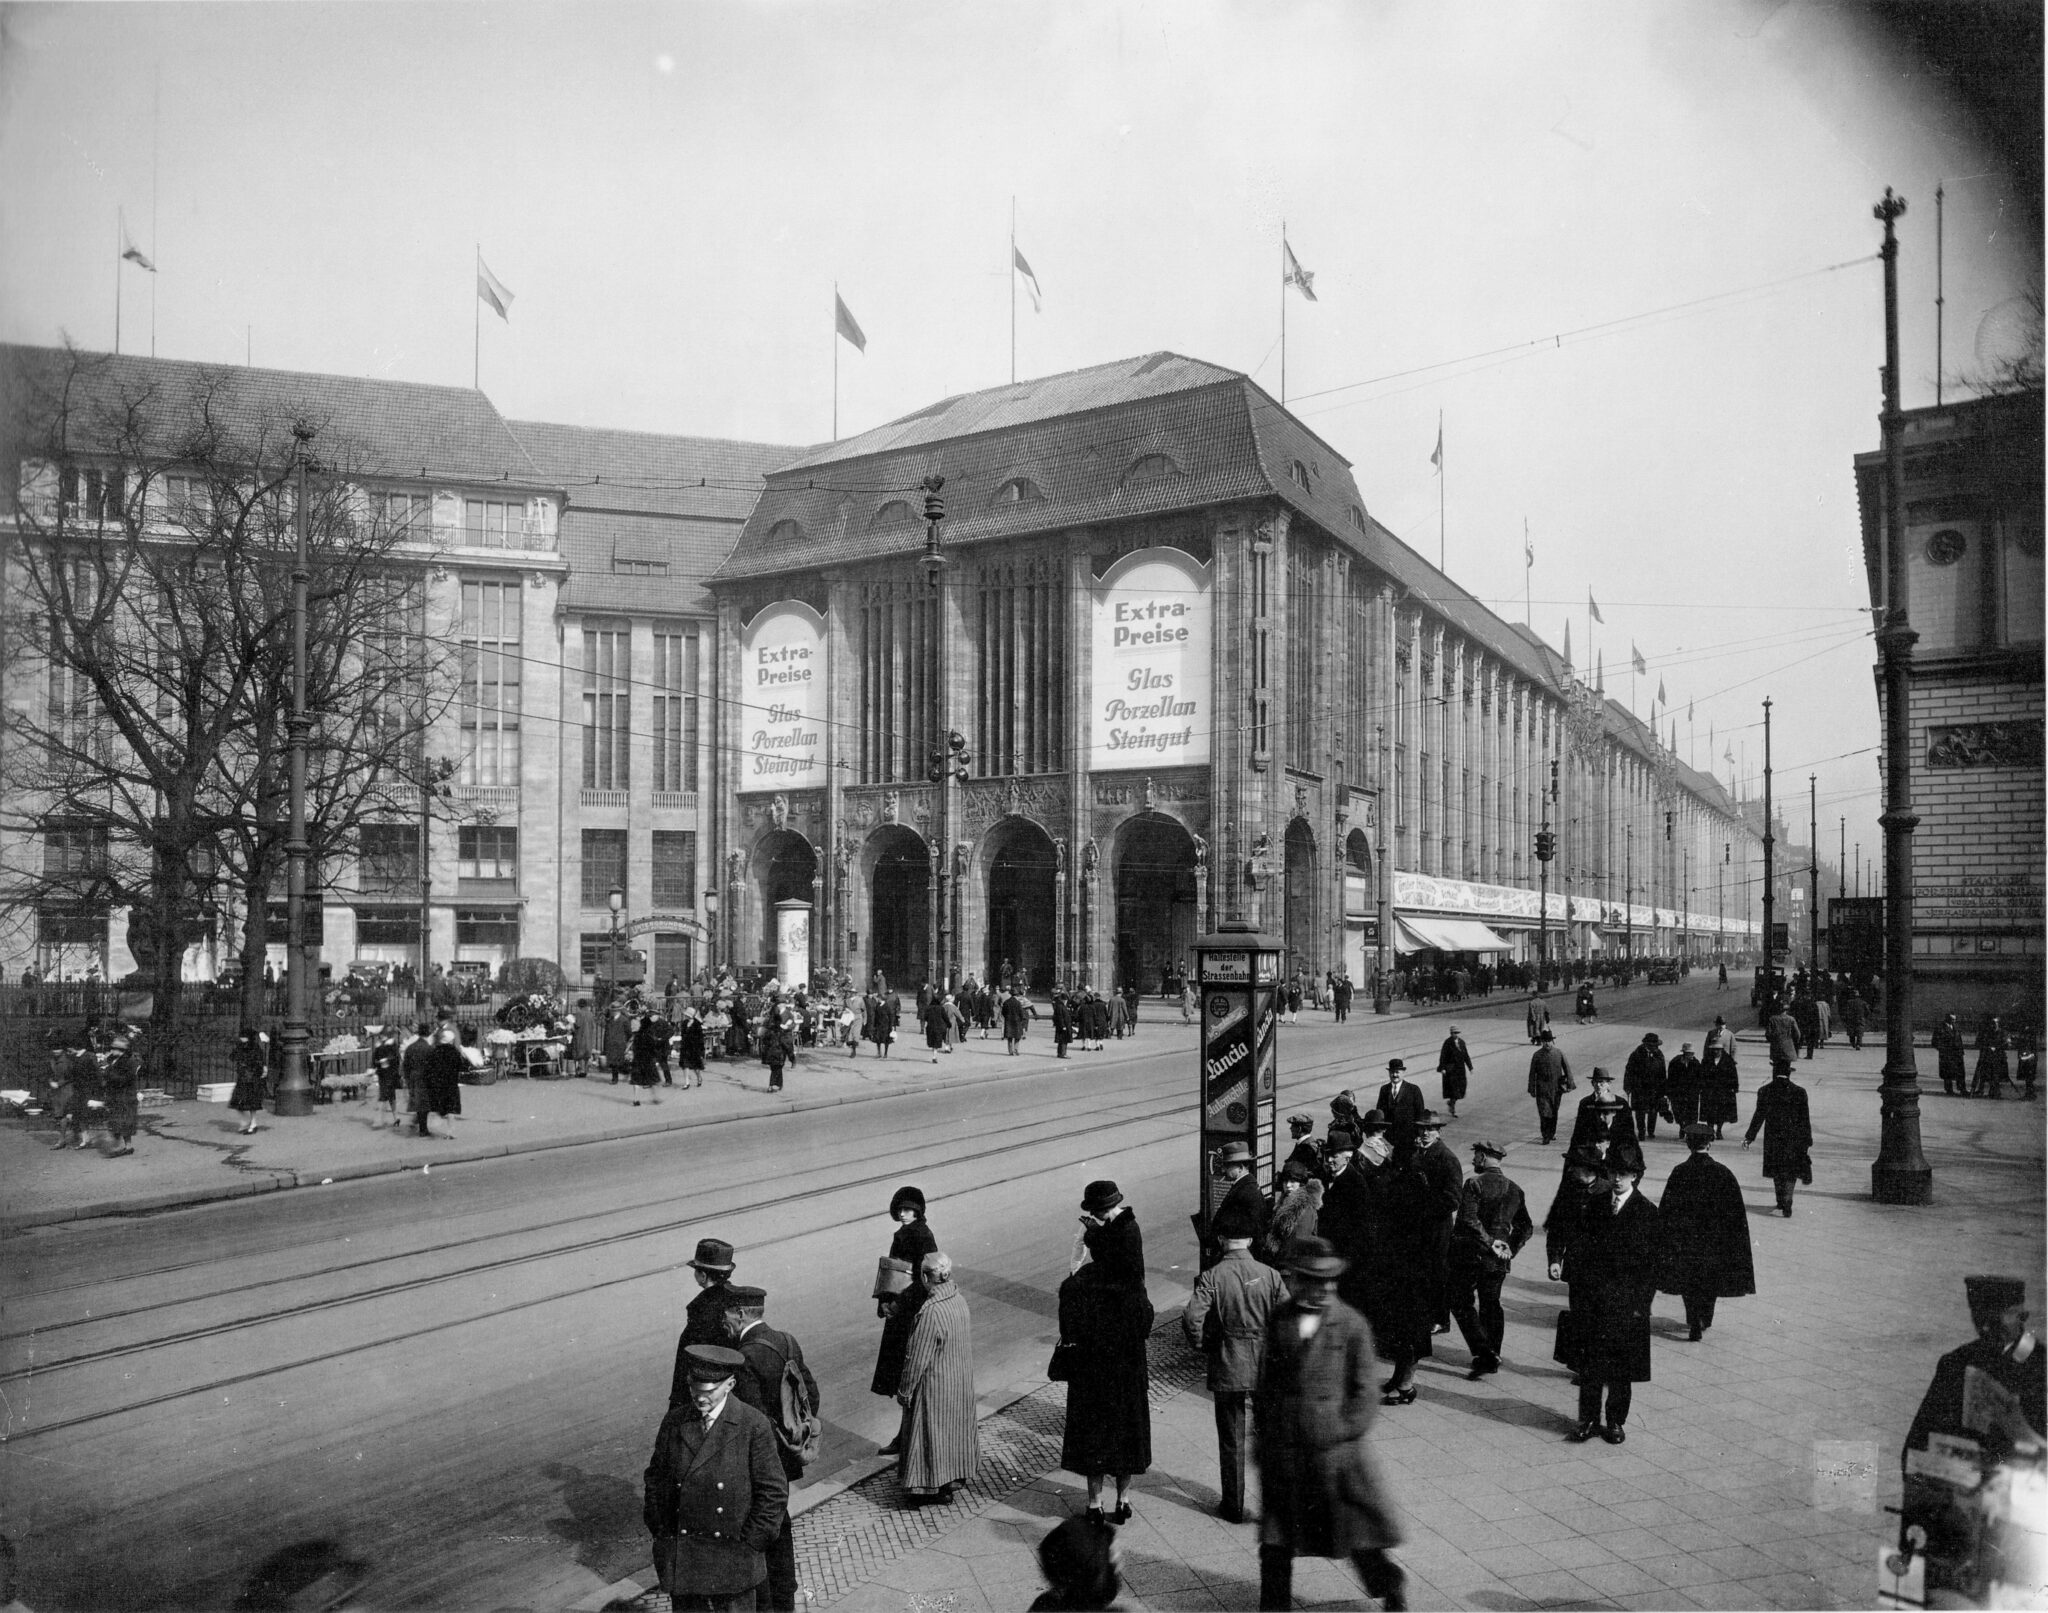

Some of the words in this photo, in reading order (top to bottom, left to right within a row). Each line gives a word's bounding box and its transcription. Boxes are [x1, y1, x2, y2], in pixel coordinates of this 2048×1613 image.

[1115, 600, 1191, 623] Extra-
[1114, 622, 1189, 647] Preise
[758, 646, 813, 664] Extra-
[758, 665, 812, 685] Preise
[1127, 667, 1173, 691] Glas
[768, 704, 801, 724] Glas
[1104, 695, 1196, 722] Porzellan
[752, 728, 818, 750] Porzellan
[1107, 726, 1192, 752] Steingut
[753, 754, 814, 777] Steingut
[1220, 963, 1233, 971] der
[1207, 1042, 1249, 1081] Lancia
[1207, 1080, 1249, 1118] Automobile
